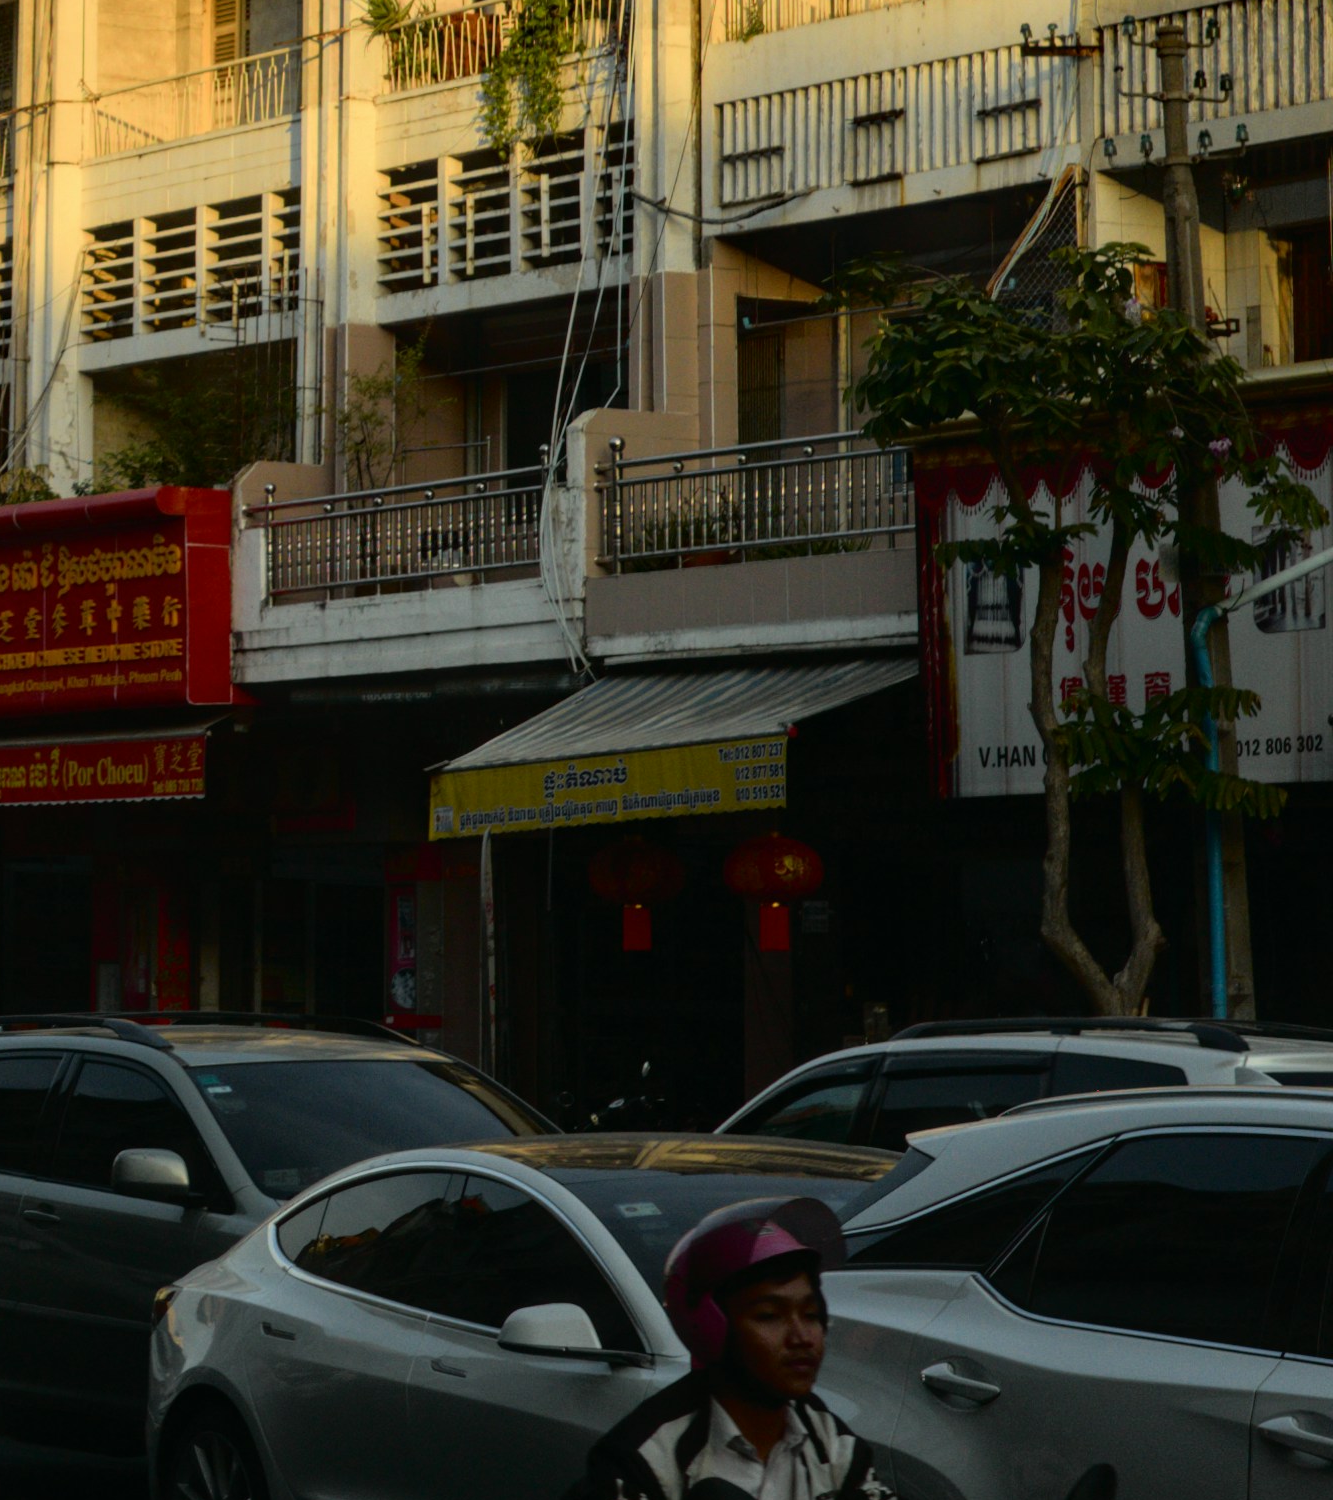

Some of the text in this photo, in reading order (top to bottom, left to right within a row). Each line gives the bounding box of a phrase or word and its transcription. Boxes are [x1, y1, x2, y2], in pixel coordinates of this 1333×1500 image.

[36, 646, 85, 668] CHINESE
[85, 643, 142, 664] MEDICINE
[141, 638, 183, 659] STORE
[130, 671, 159, 684] Phnom
[160, 668, 182, 682] Penh
[769, 742, 784, 758] 237
[979, 745, 1036, 768] V.HAN
[1236, 734, 1323, 757] 012 806 302
[153, 742, 202, 776] 寶芝堂
[62, 754, 148, 791] (Por Choeu)
[735, 766, 750, 781] 012
[769, 763, 784, 778] 581
[752, 785, 768, 800] 519
